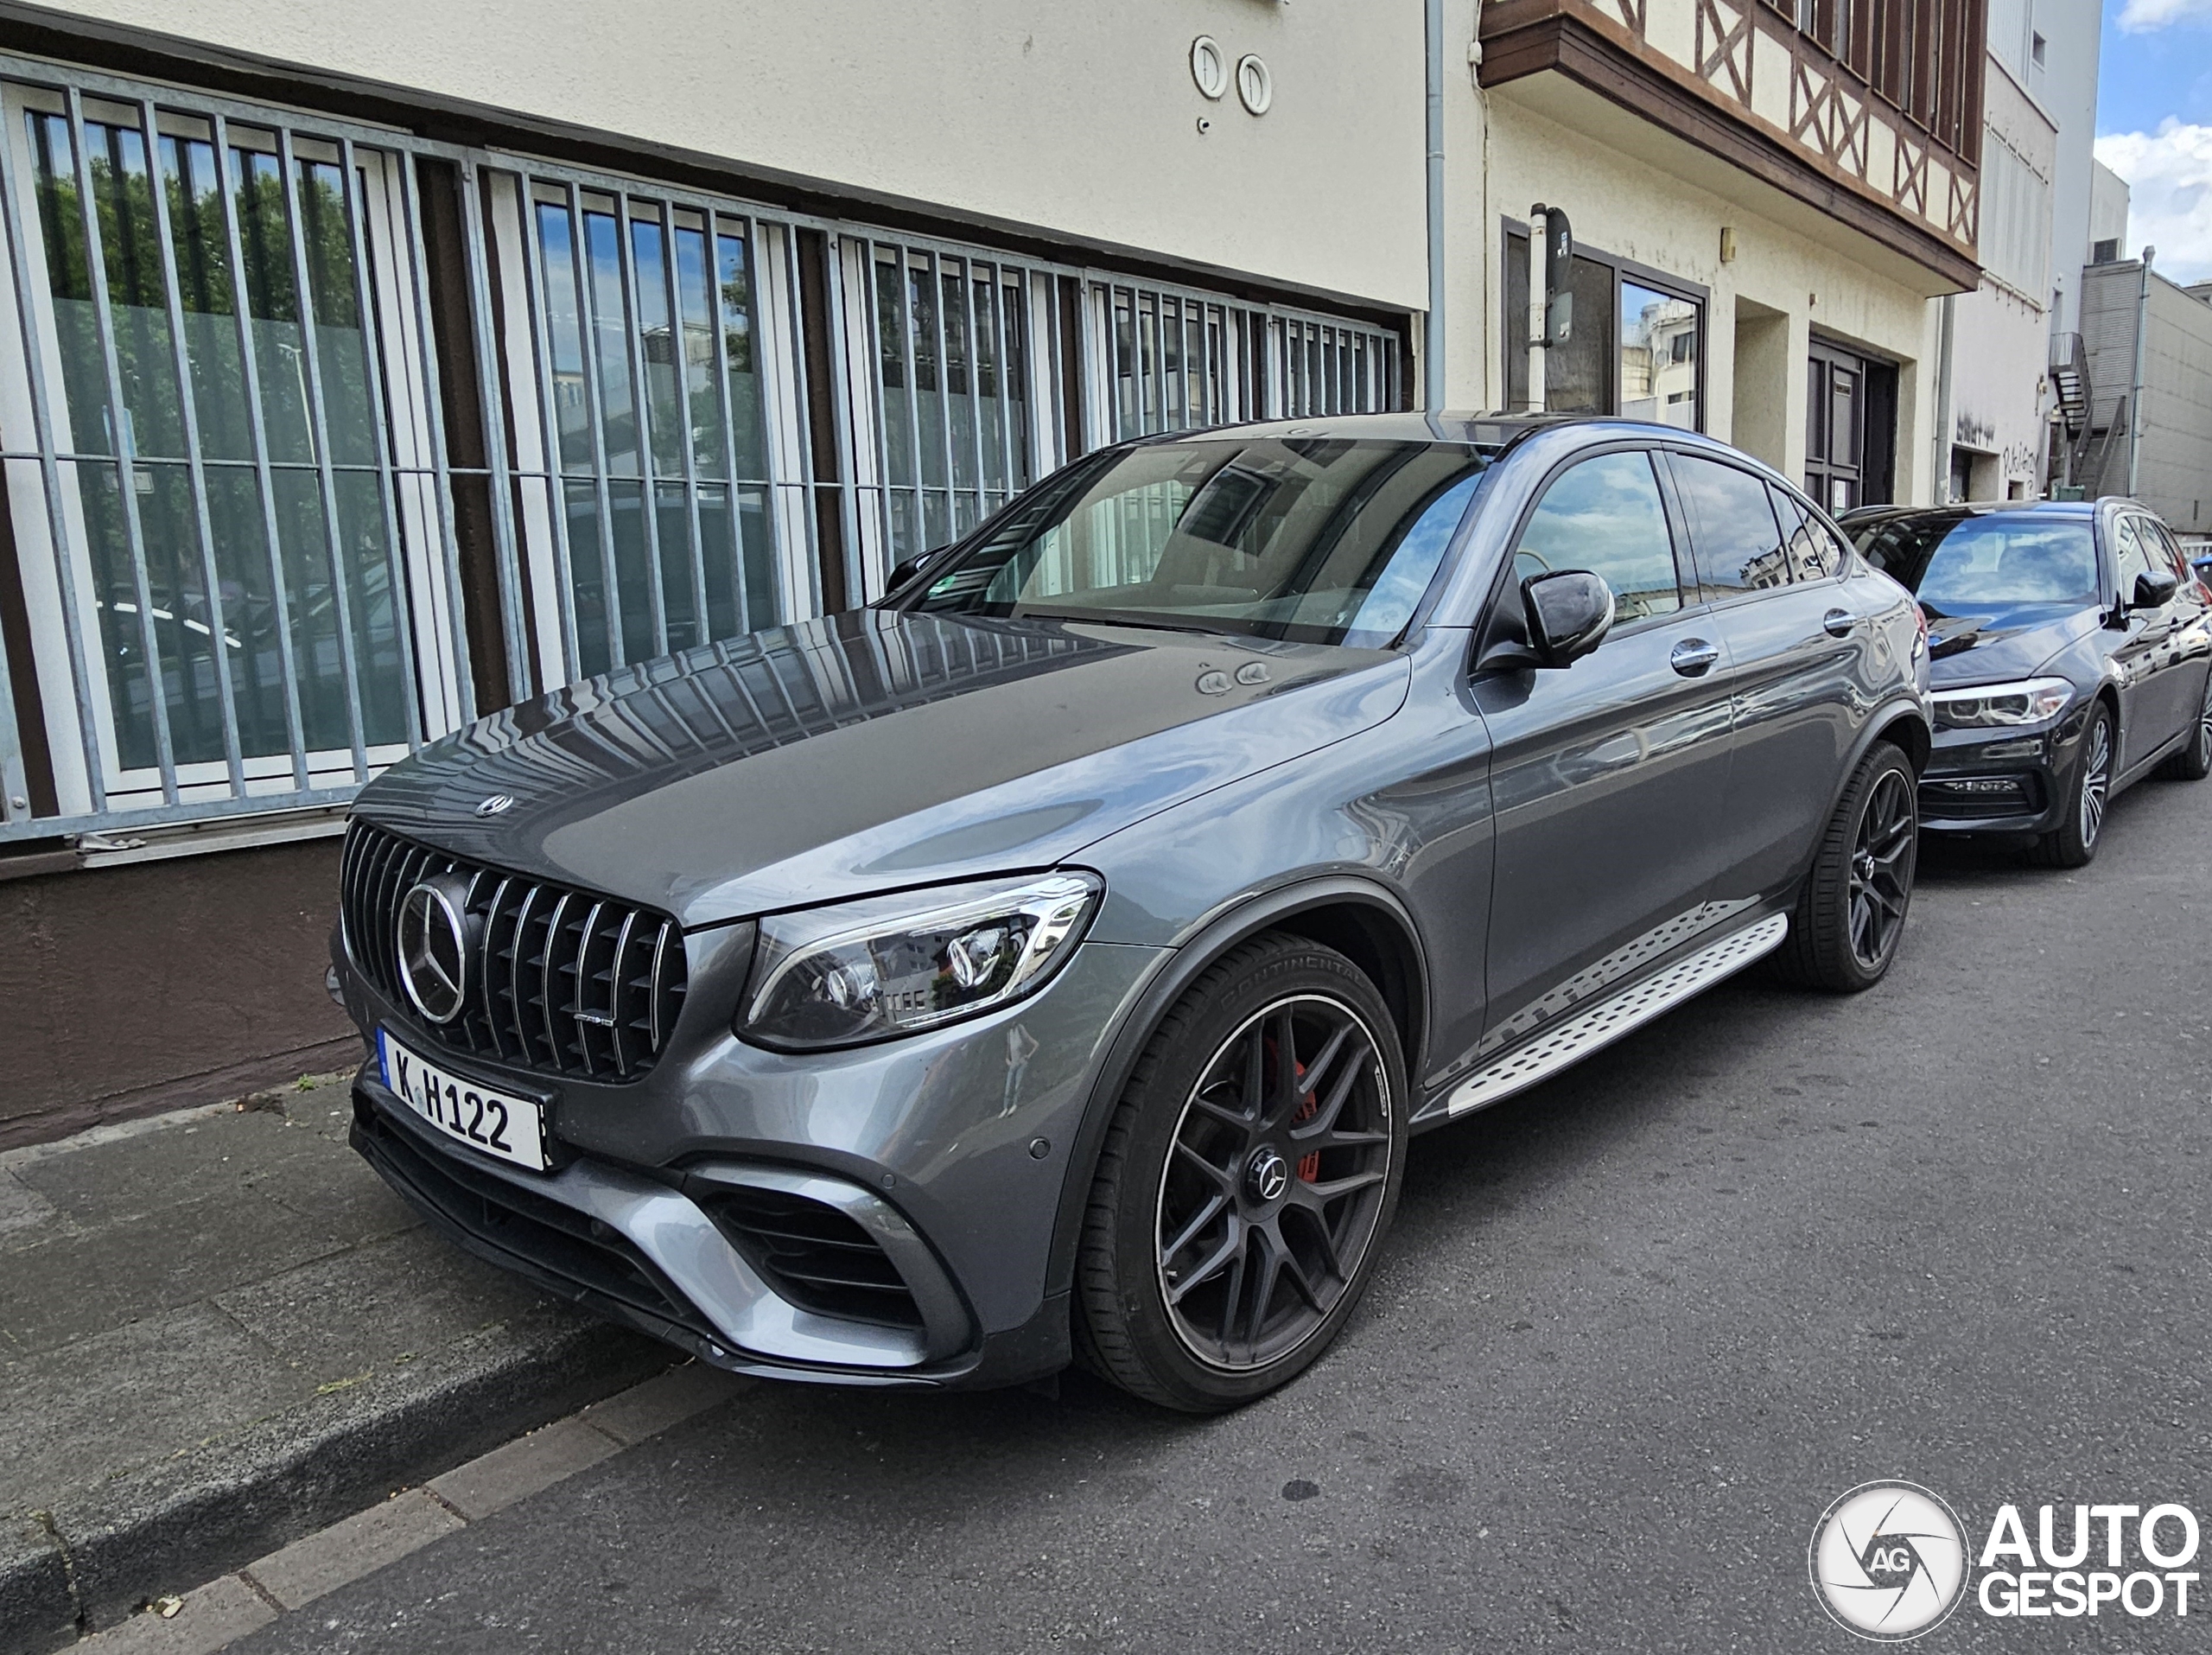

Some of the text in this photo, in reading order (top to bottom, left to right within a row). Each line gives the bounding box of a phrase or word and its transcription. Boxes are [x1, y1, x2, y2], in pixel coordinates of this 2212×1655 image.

[1221, 955, 1366, 1011] CONTINENTAL
[396, 1050, 512, 1153] K H122
